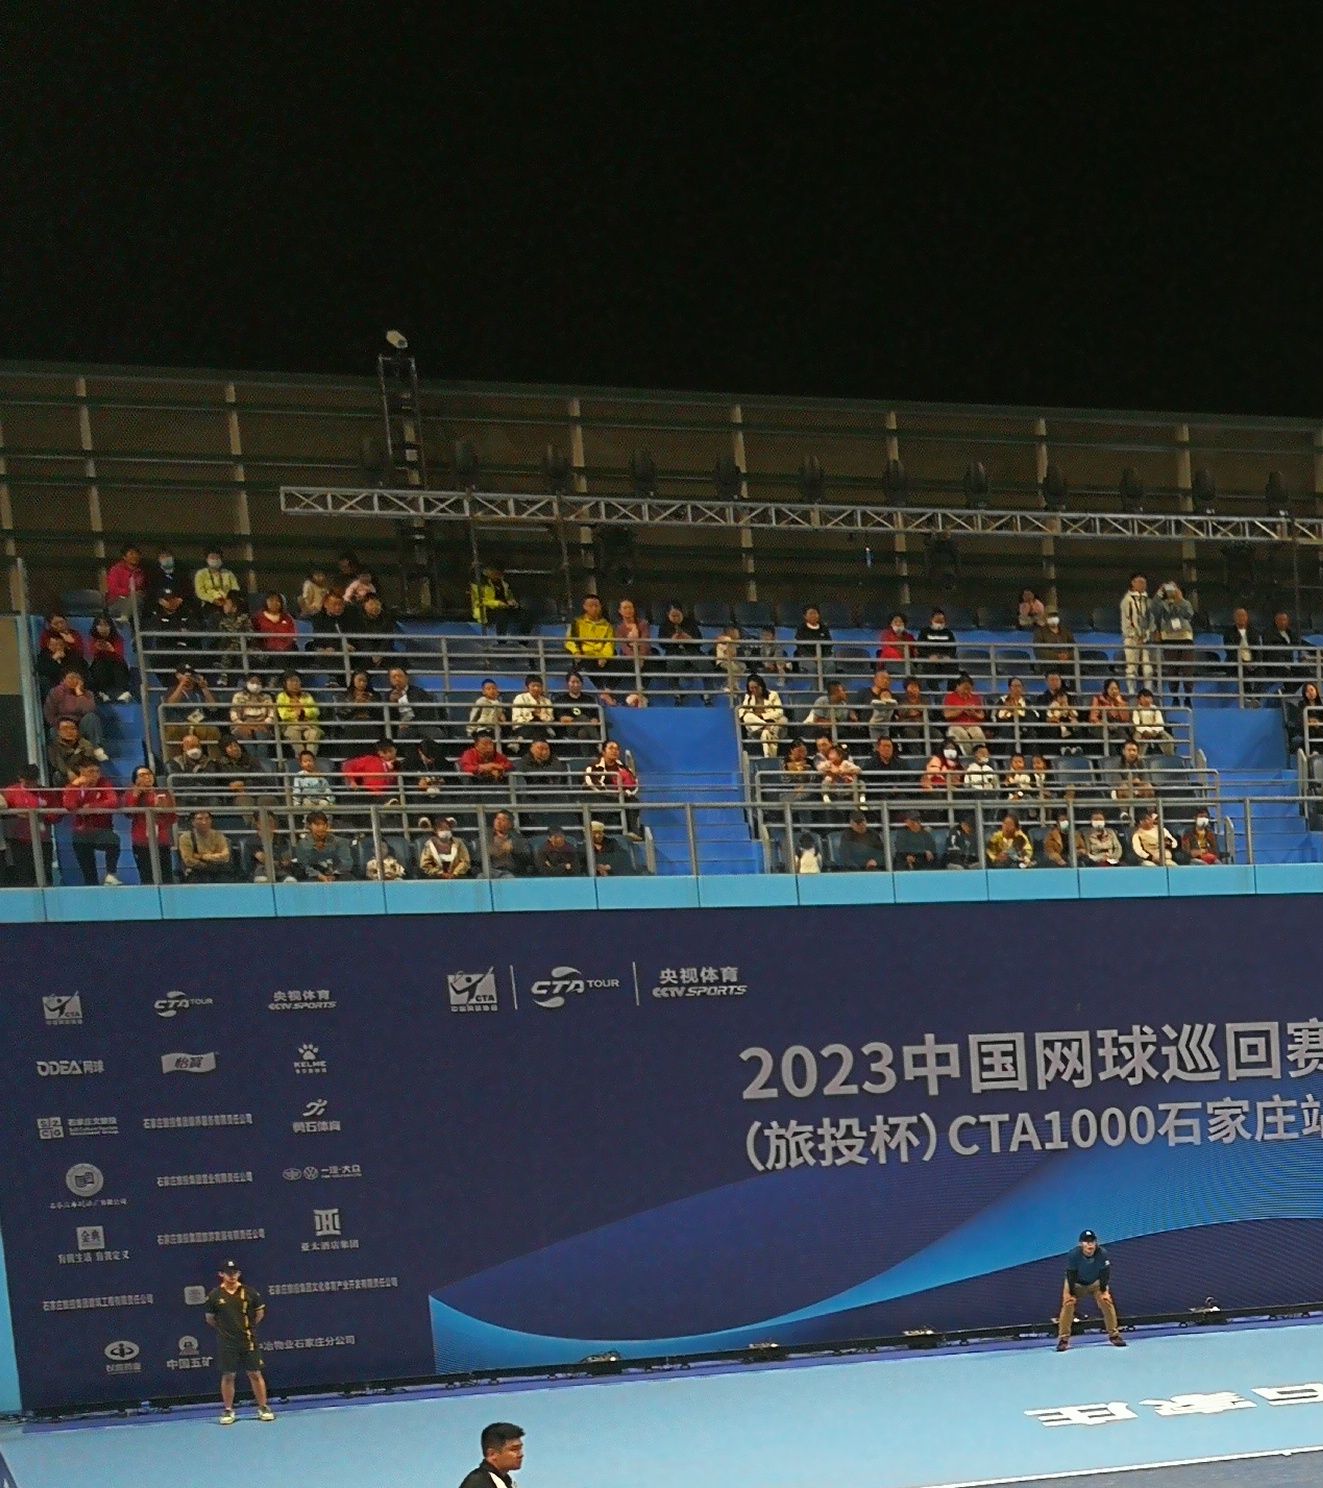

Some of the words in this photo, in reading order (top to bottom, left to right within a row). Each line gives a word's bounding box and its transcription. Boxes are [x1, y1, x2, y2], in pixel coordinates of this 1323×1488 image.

[659, 966, 739, 984] 央视体育
[531, 980, 585, 994] CTA
[587, 978, 620, 989] TOUR
[685, 985, 748, 997] SPORTS
[259, 1335, 356, 1351] 冶物业石家庄分公司
